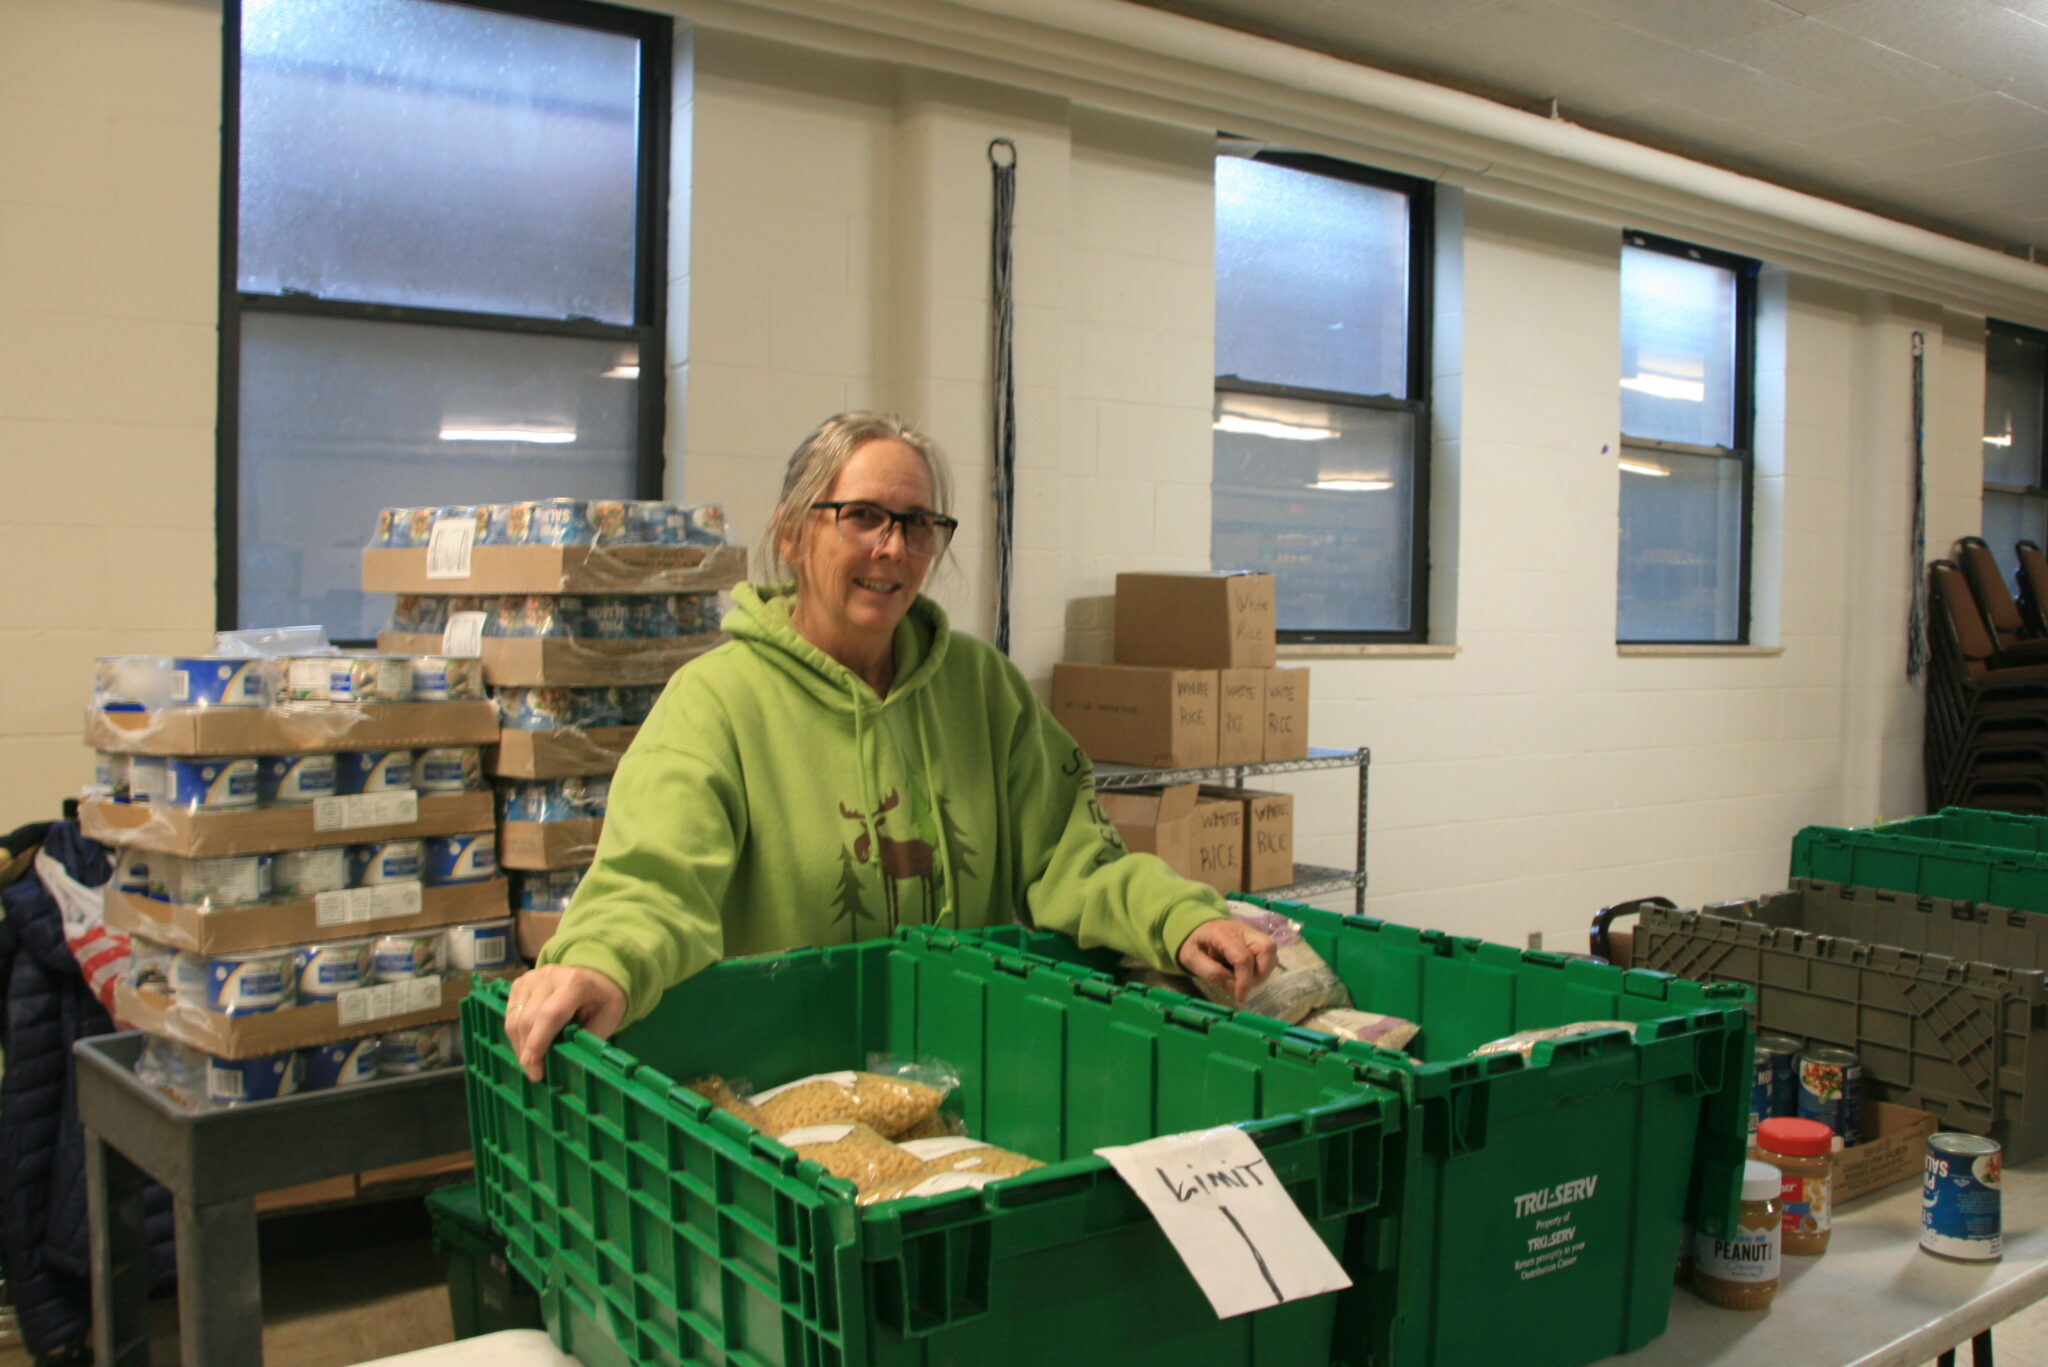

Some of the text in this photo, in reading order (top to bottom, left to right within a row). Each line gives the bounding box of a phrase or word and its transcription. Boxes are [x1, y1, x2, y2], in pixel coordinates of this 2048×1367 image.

[1268, 712, 1293, 734] RICE
[1257, 831, 1287, 855] RICE
[1200, 843, 1237, 872] RICE
[1562, 1210, 1571, 1223] of
[1218, 1205, 1285, 1303] 1
[1714, 1240, 1767, 1262] PEANUT
